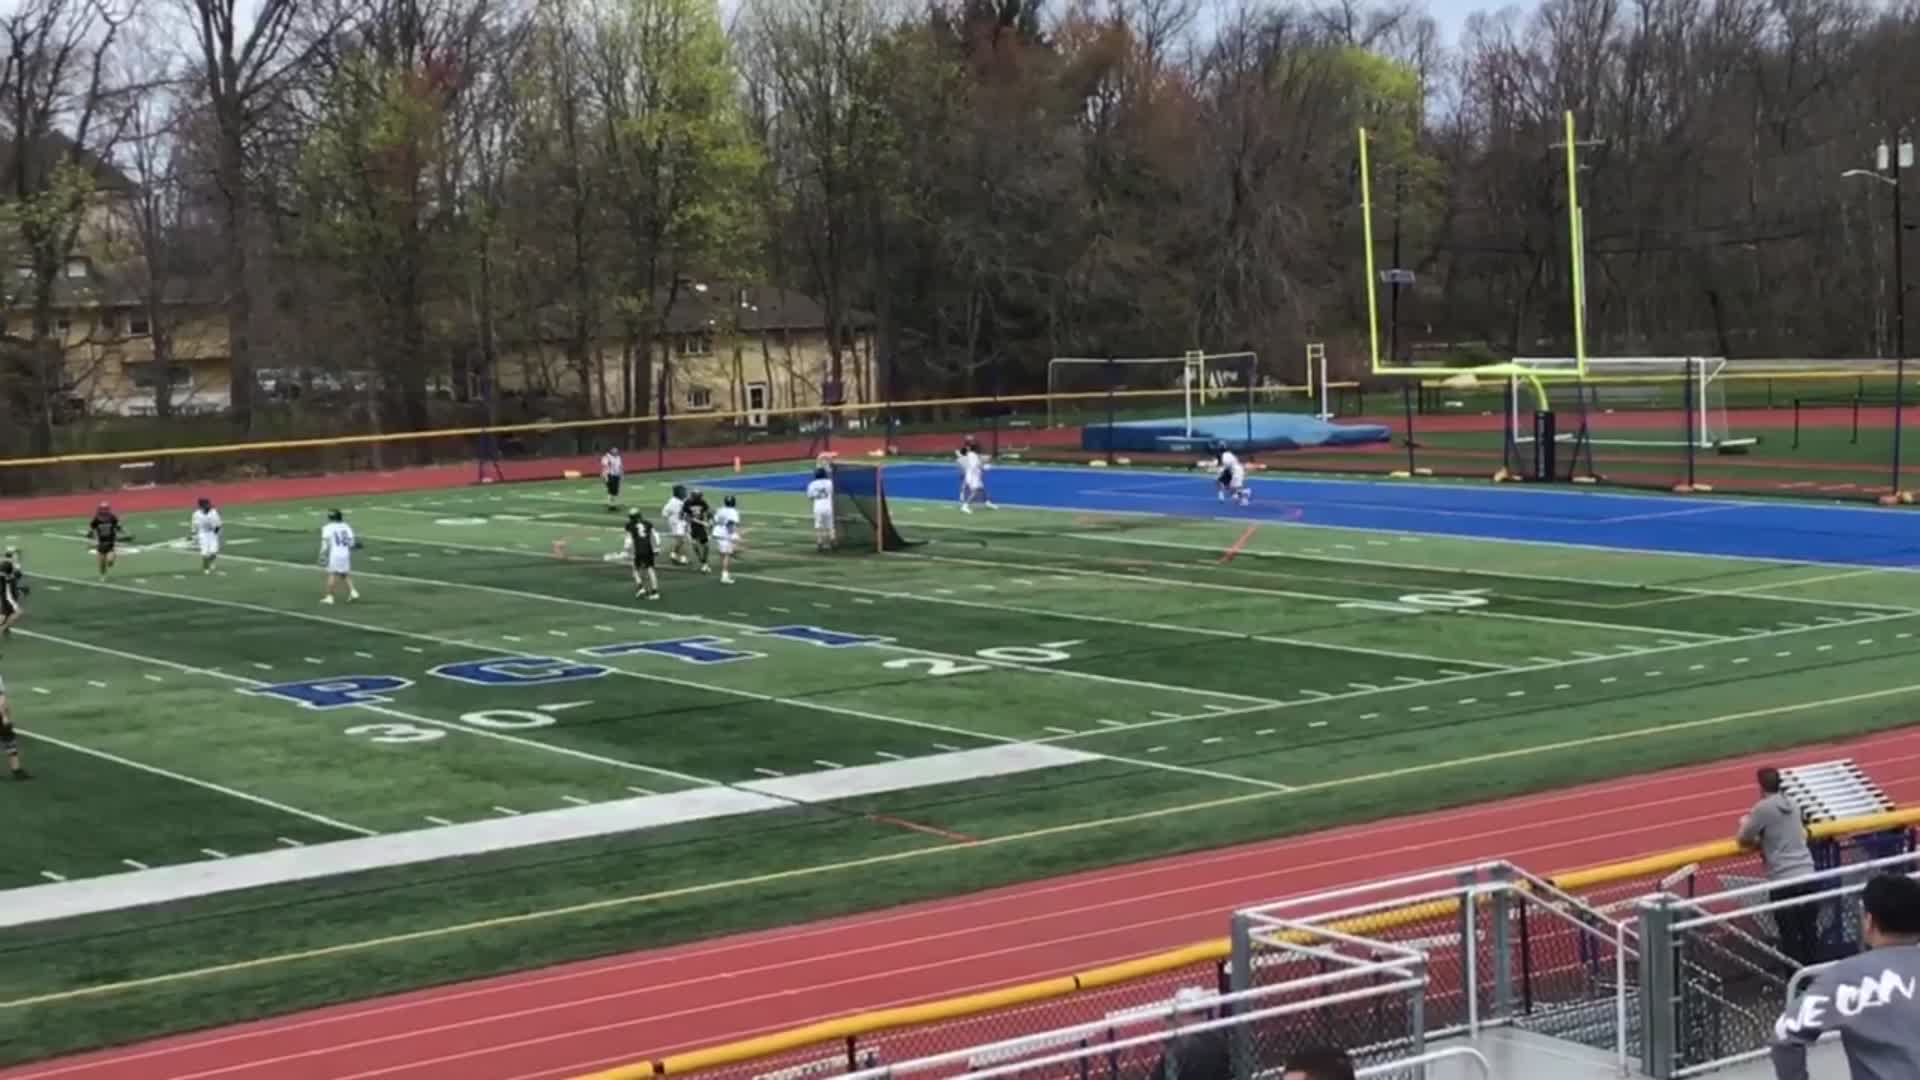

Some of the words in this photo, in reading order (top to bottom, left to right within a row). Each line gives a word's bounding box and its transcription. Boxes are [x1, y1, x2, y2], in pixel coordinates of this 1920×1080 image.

[238, 624, 896, 709] PCTI
[882, 646, 1071, 675] 20
[344, 709, 557, 743] 30
